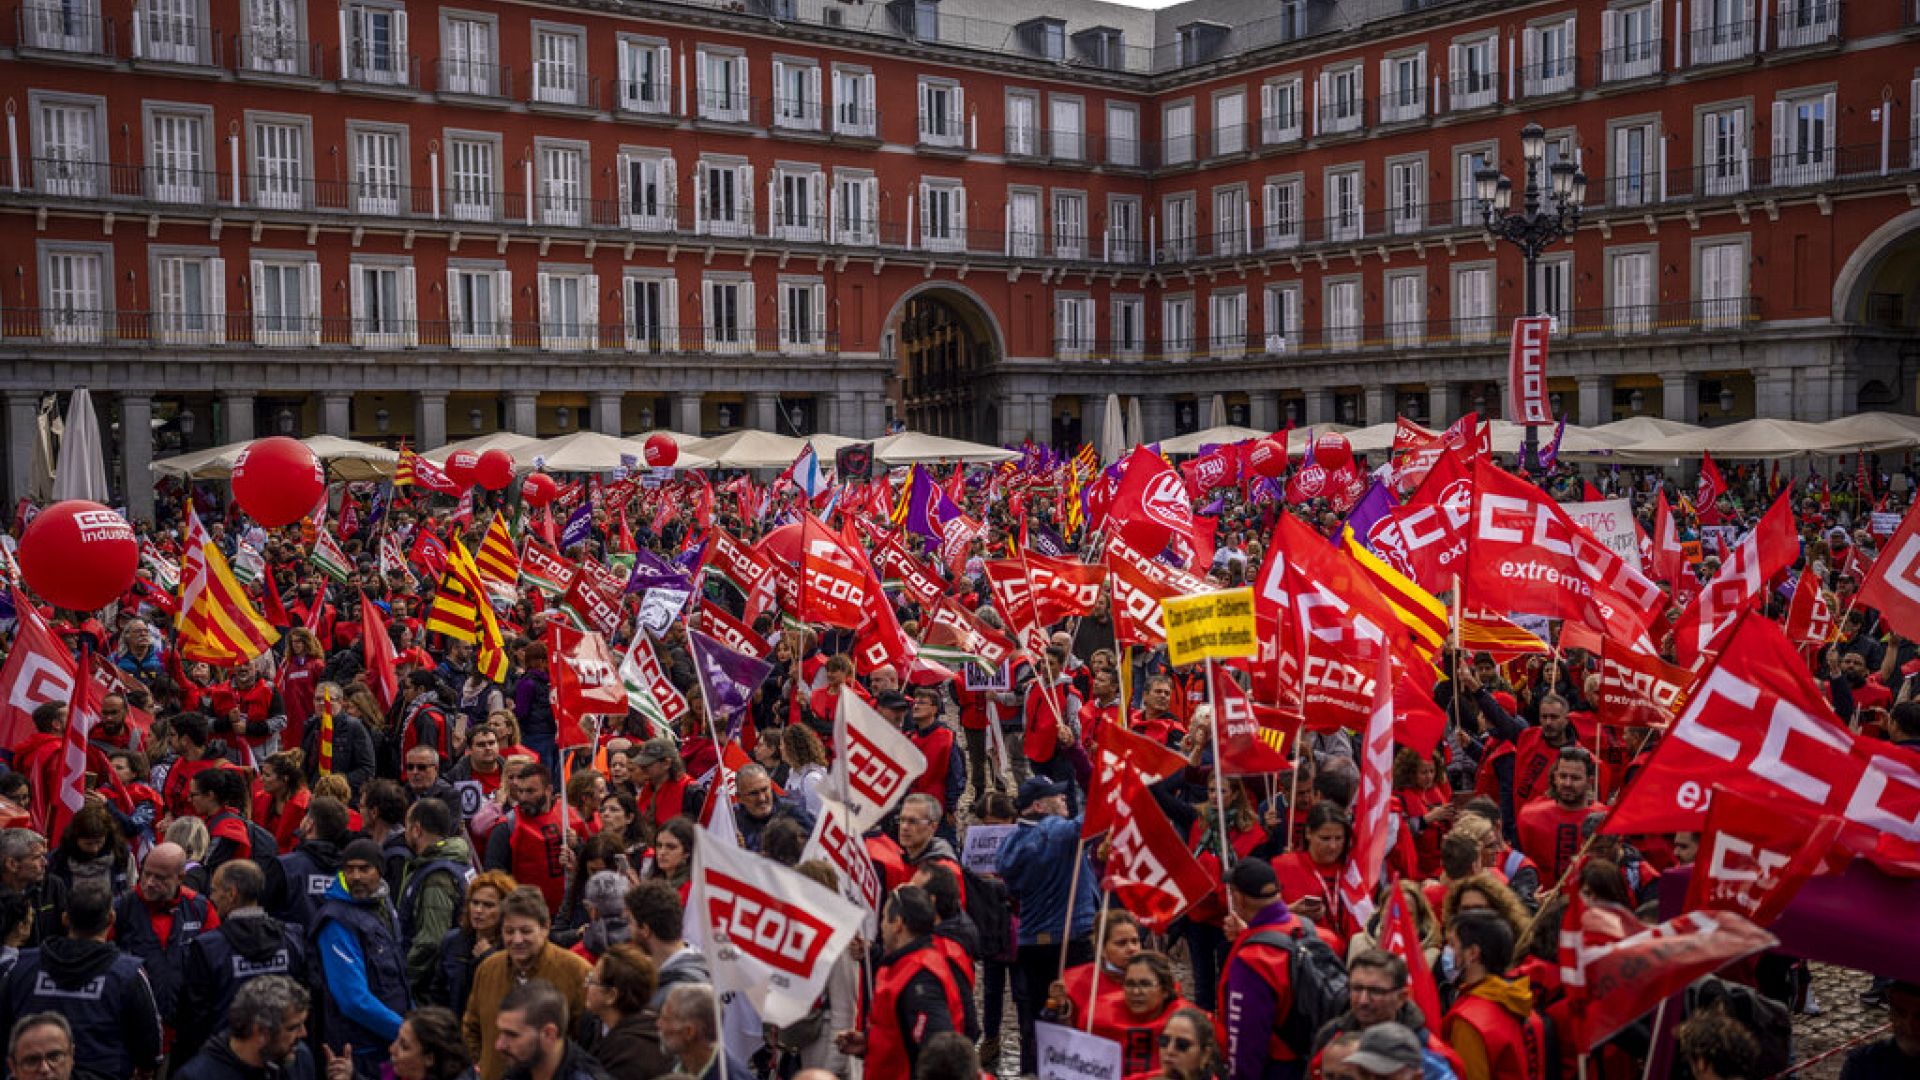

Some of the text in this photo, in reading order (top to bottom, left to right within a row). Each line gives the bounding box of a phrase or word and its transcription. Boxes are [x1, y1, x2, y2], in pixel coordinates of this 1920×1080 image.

[1523, 323, 1545, 422] CCOO
[528, 546, 573, 583] CCOO
[717, 537, 764, 579] CCOO
[887, 549, 940, 596] CCOO
[1109, 536, 1166, 582] CCOO
[577, 581, 621, 627] CCOO
[633, 637, 687, 721] CCOO
[846, 734, 898, 798] COO
[705, 884, 817, 963] CCOO
